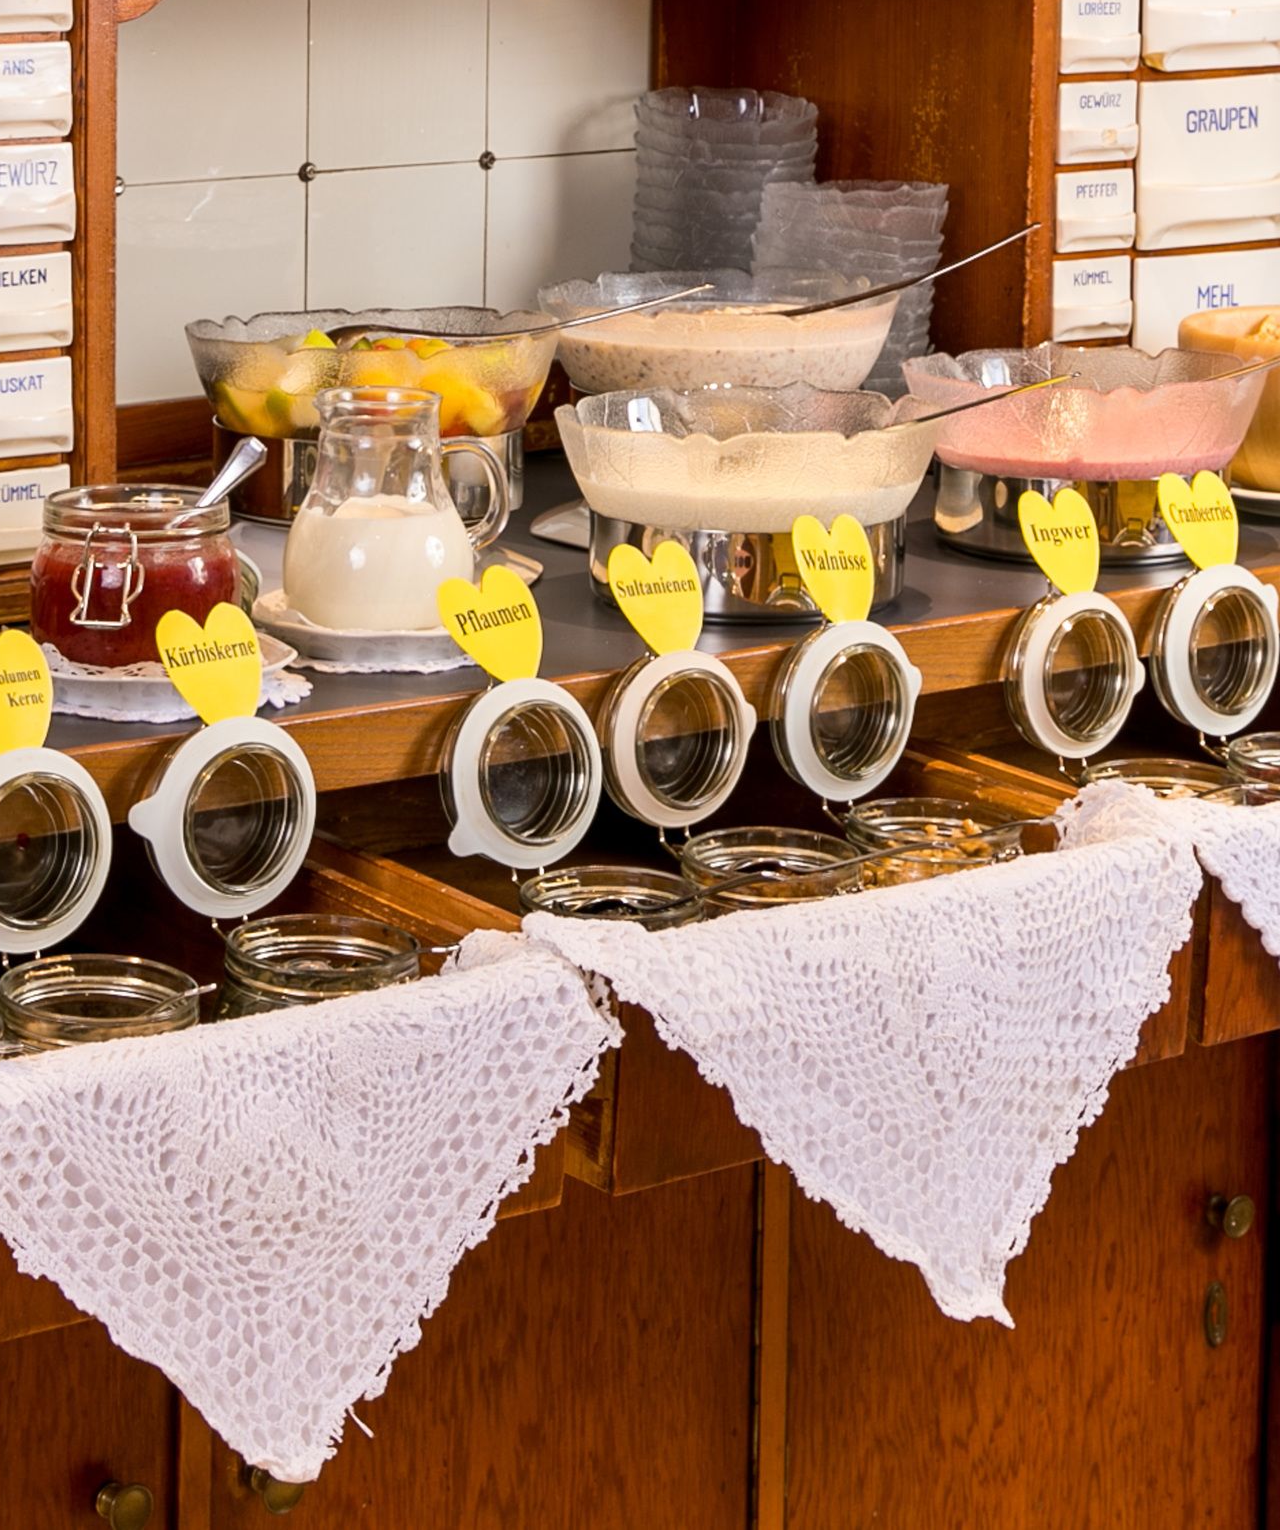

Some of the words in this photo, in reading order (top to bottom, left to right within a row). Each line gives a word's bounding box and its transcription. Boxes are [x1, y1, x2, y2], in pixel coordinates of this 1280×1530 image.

[1078, 1, 1122, 16] LORBEER
[2, 59, 35, 75] ANIS
[1079, 93, 1122, 110] GEWÜRZ
[1186, 106, 1258, 133] GRAUPEN
[1076, 182, 1118, 199] PFEFFER
[1073, 270, 1113, 286] KÜMMEL
[1196, 284, 1239, 309] MEHL
[1029, 521, 1091, 548] Ingwer
[800, 549, 868, 572] Walnüsse
[454, 599, 532, 637] Pflaumen
[164, 638, 256, 669] Kürbiskerne
[7, 690, 45, 709] Kerne
